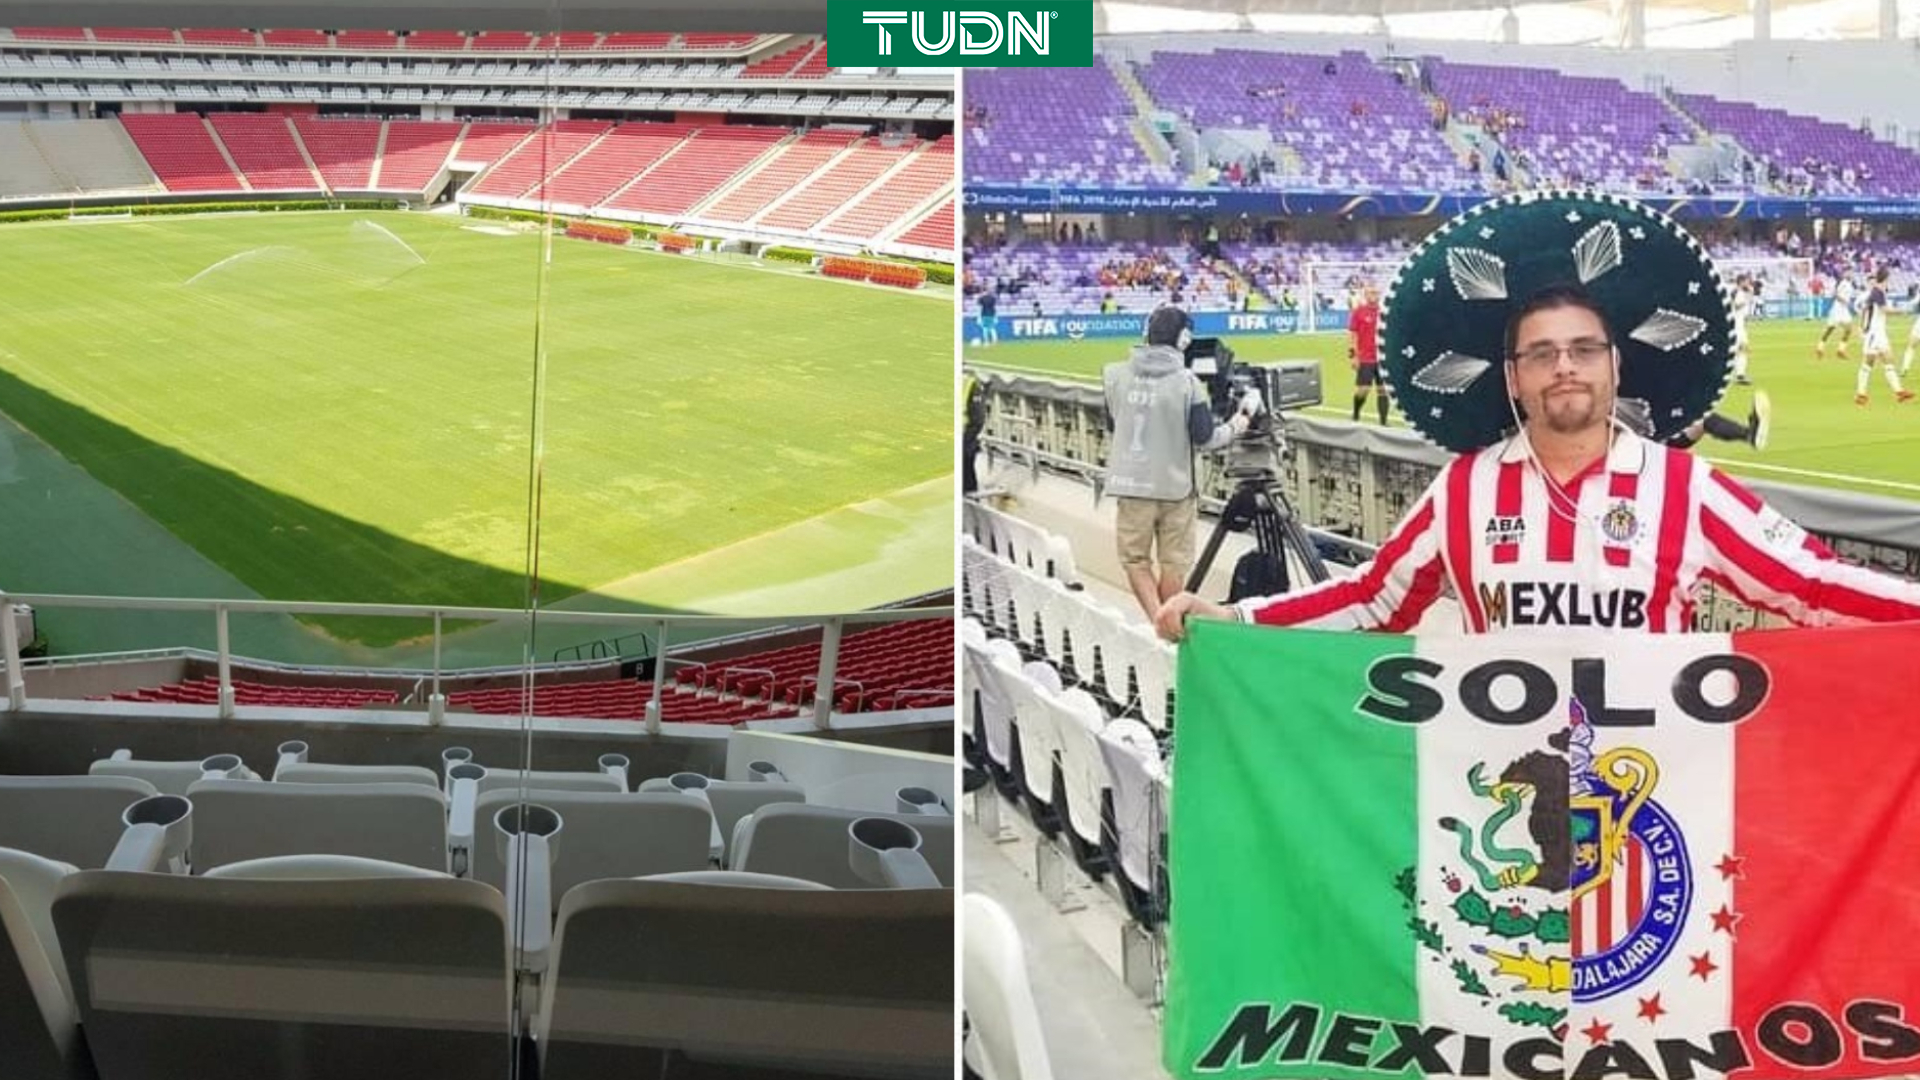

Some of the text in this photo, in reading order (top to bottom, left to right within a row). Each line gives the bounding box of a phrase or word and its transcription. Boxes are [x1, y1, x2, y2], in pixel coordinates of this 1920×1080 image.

[1012, 318, 1058, 336] FIFA
[1228, 314, 1268, 330] FIFA
[1485, 517, 1526, 532] ABA
[1479, 580, 1647, 629] MEXLUB
[1355, 653, 1771, 727] SOLO
[1658, 857, 1680, 882] DE
[1192, 1000, 1920, 1080] MEXICANOS
